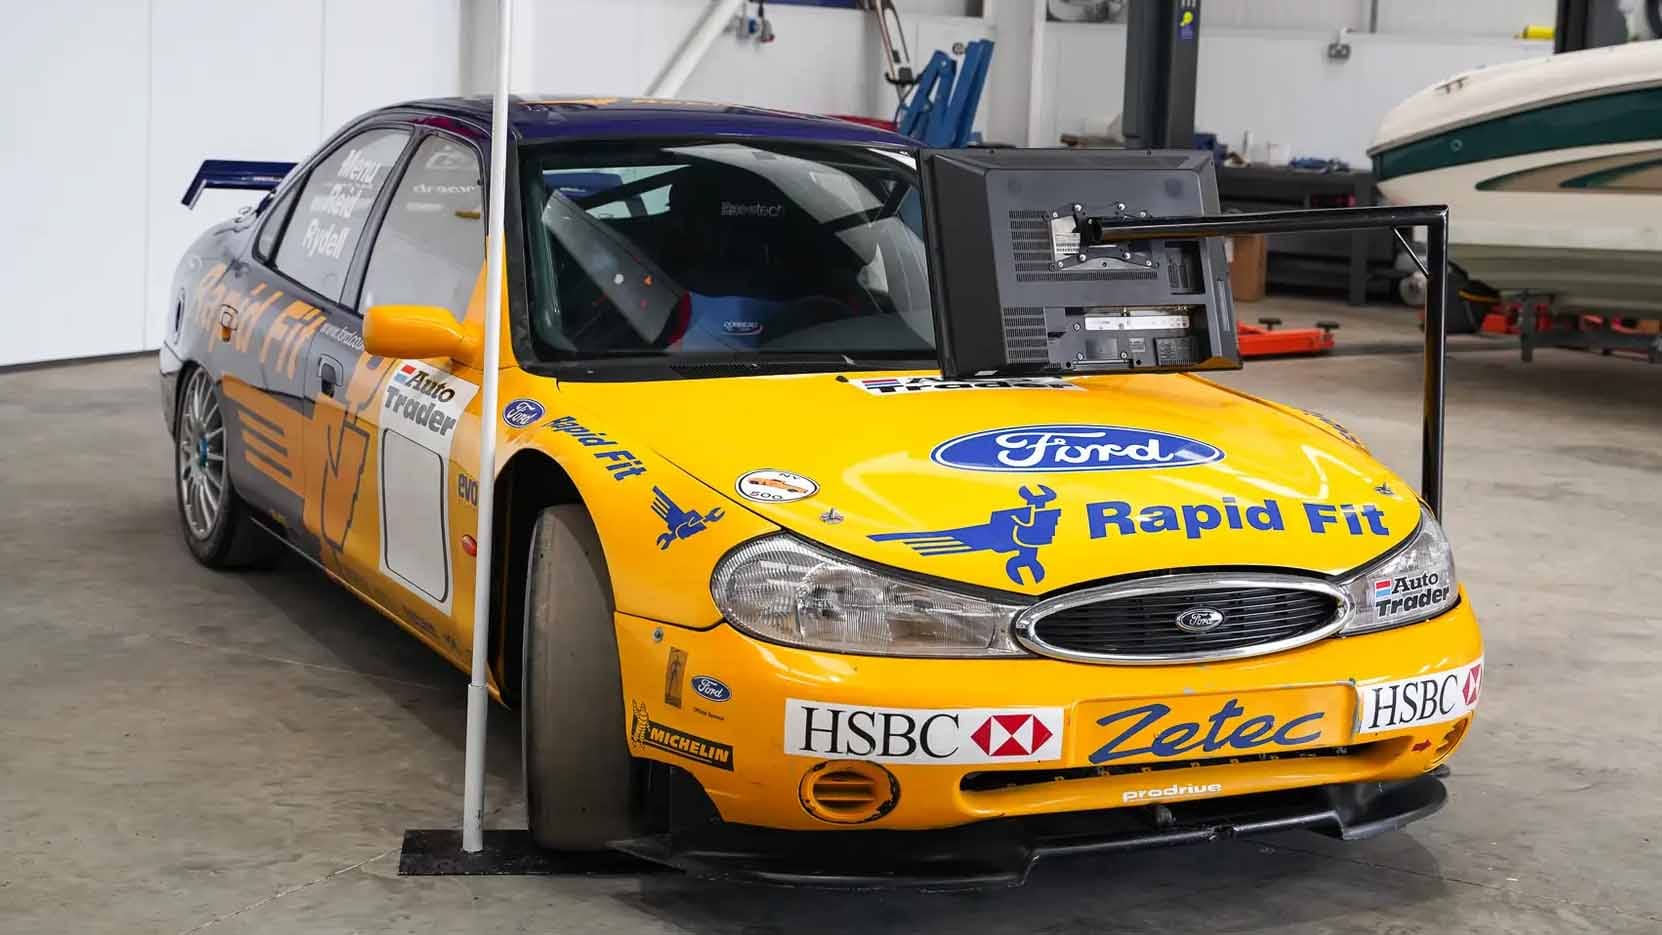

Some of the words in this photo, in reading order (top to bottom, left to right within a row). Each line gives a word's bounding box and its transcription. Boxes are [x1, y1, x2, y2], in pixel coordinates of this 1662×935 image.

[338, 149, 381, 183] Menu
[259, 300, 327, 380] Fit
[405, 370, 456, 403] Auto
[867, 381, 1073, 393] Trader
[385, 386, 457, 436] Trader
[506, 401, 538, 425] Ford
[543, 416, 618, 447] Rapid
[593, 450, 647, 481] Fit
[995, 431, 1176, 466] Ford
[458, 474, 479, 506] evo
[750, 491, 783, 500] 500
[1087, 496, 1284, 539] Rapid
[1304, 501, 1390, 537] Fit
[1391, 573, 1439, 595] Auto
[1375, 586, 1450, 617] Trader
[697, 678, 723, 698] Ford
[1368, 674, 1458, 729] HSBC
[650, 727, 729, 763] MICHELIN
[799, 705, 960, 760] HSBC
[1088, 698, 1326, 765] Zetec
[1122, 783, 1223, 803] prodrive
